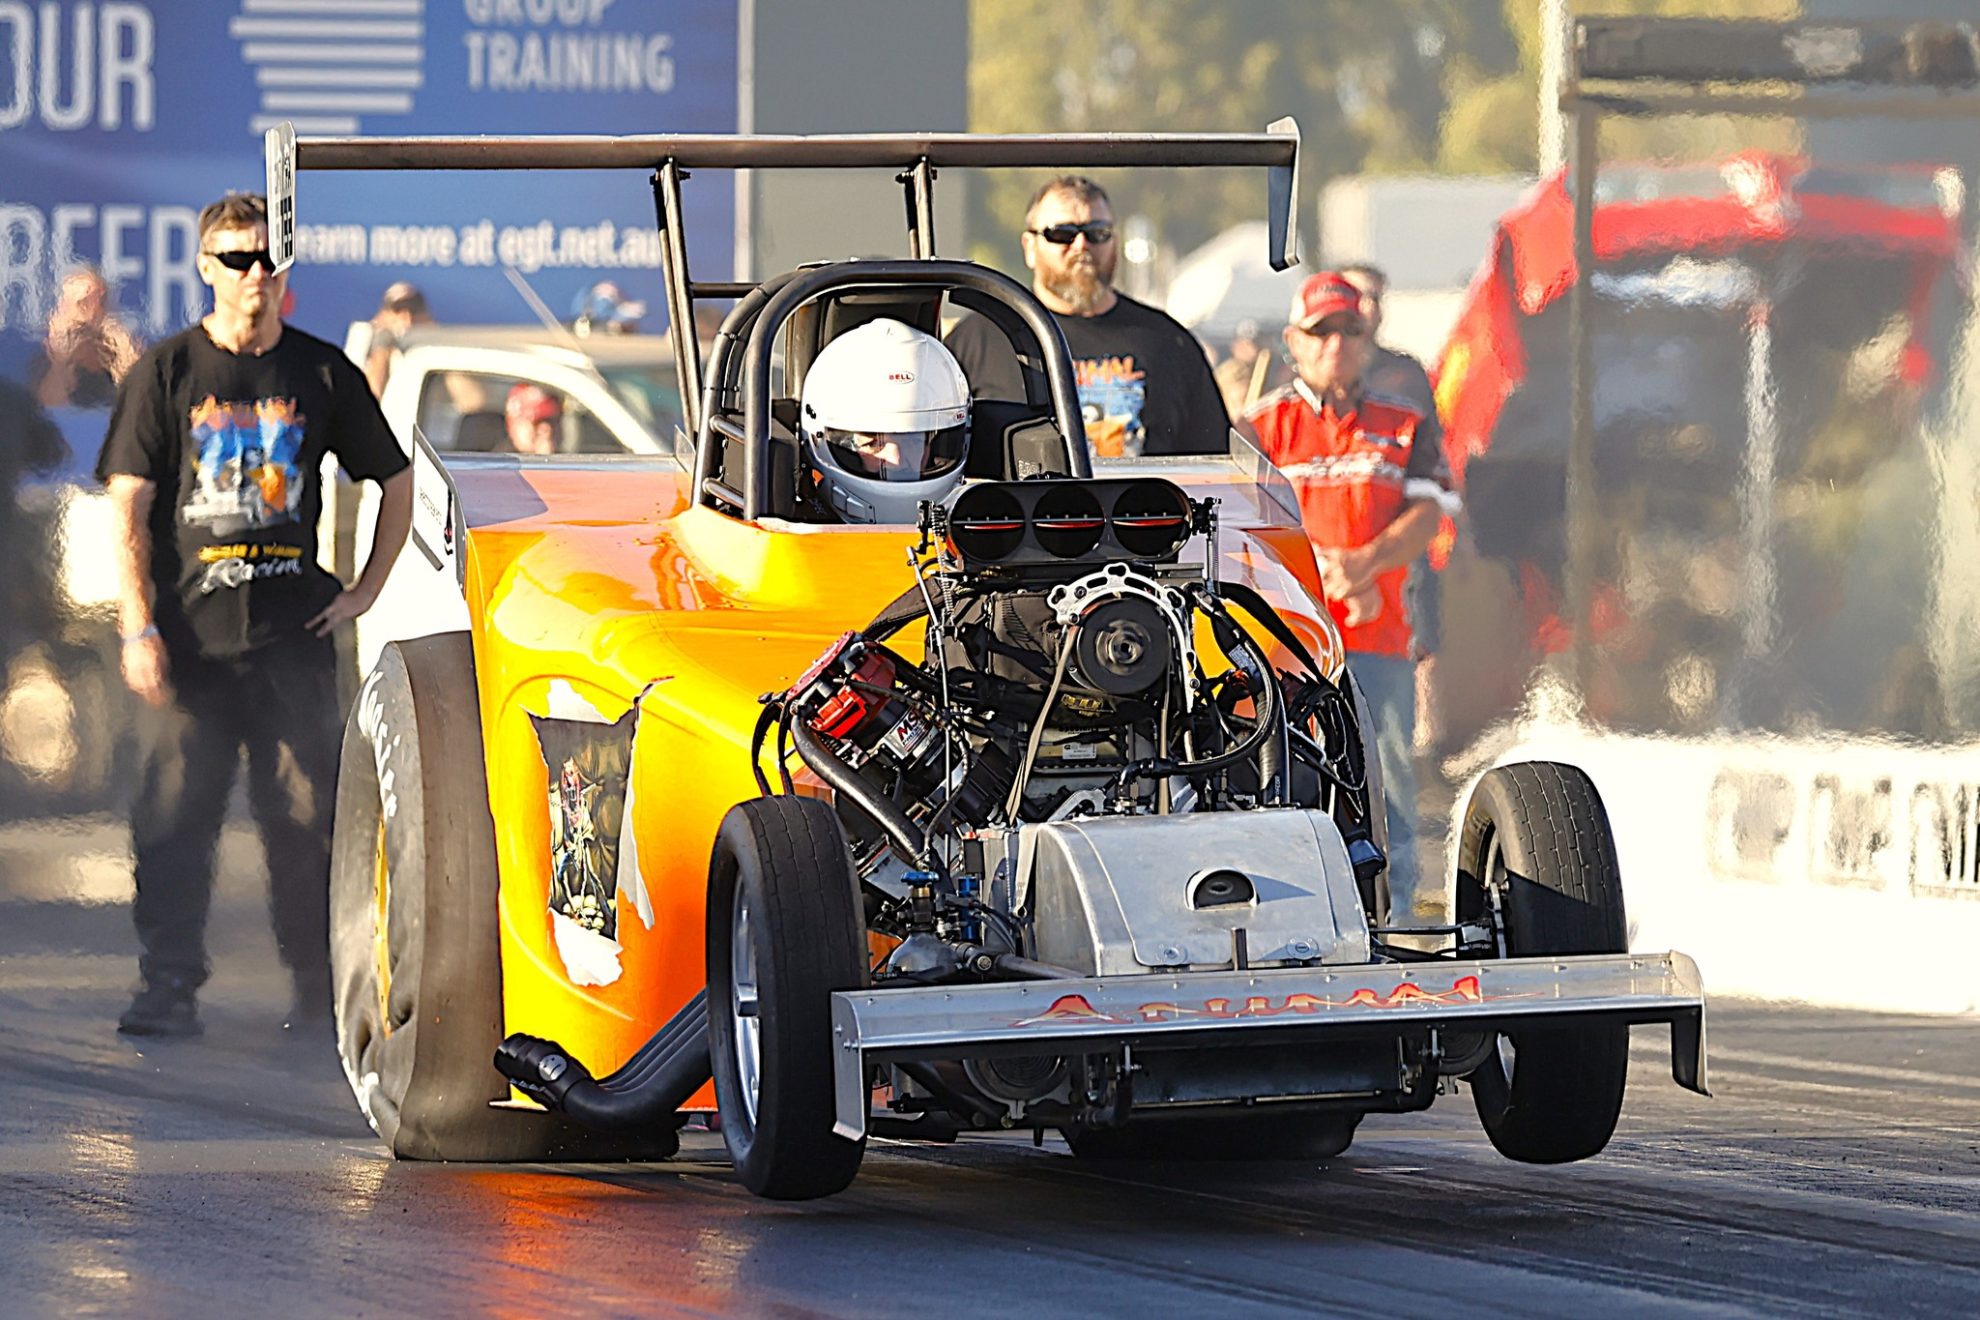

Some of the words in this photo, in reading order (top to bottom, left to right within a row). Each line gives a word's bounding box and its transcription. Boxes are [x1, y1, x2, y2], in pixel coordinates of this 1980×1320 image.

[464, 32, 674, 93] TRAINING
[295, 224, 367, 265] earn
[370, 225, 457, 267] more
[460, 219, 496, 267] at
